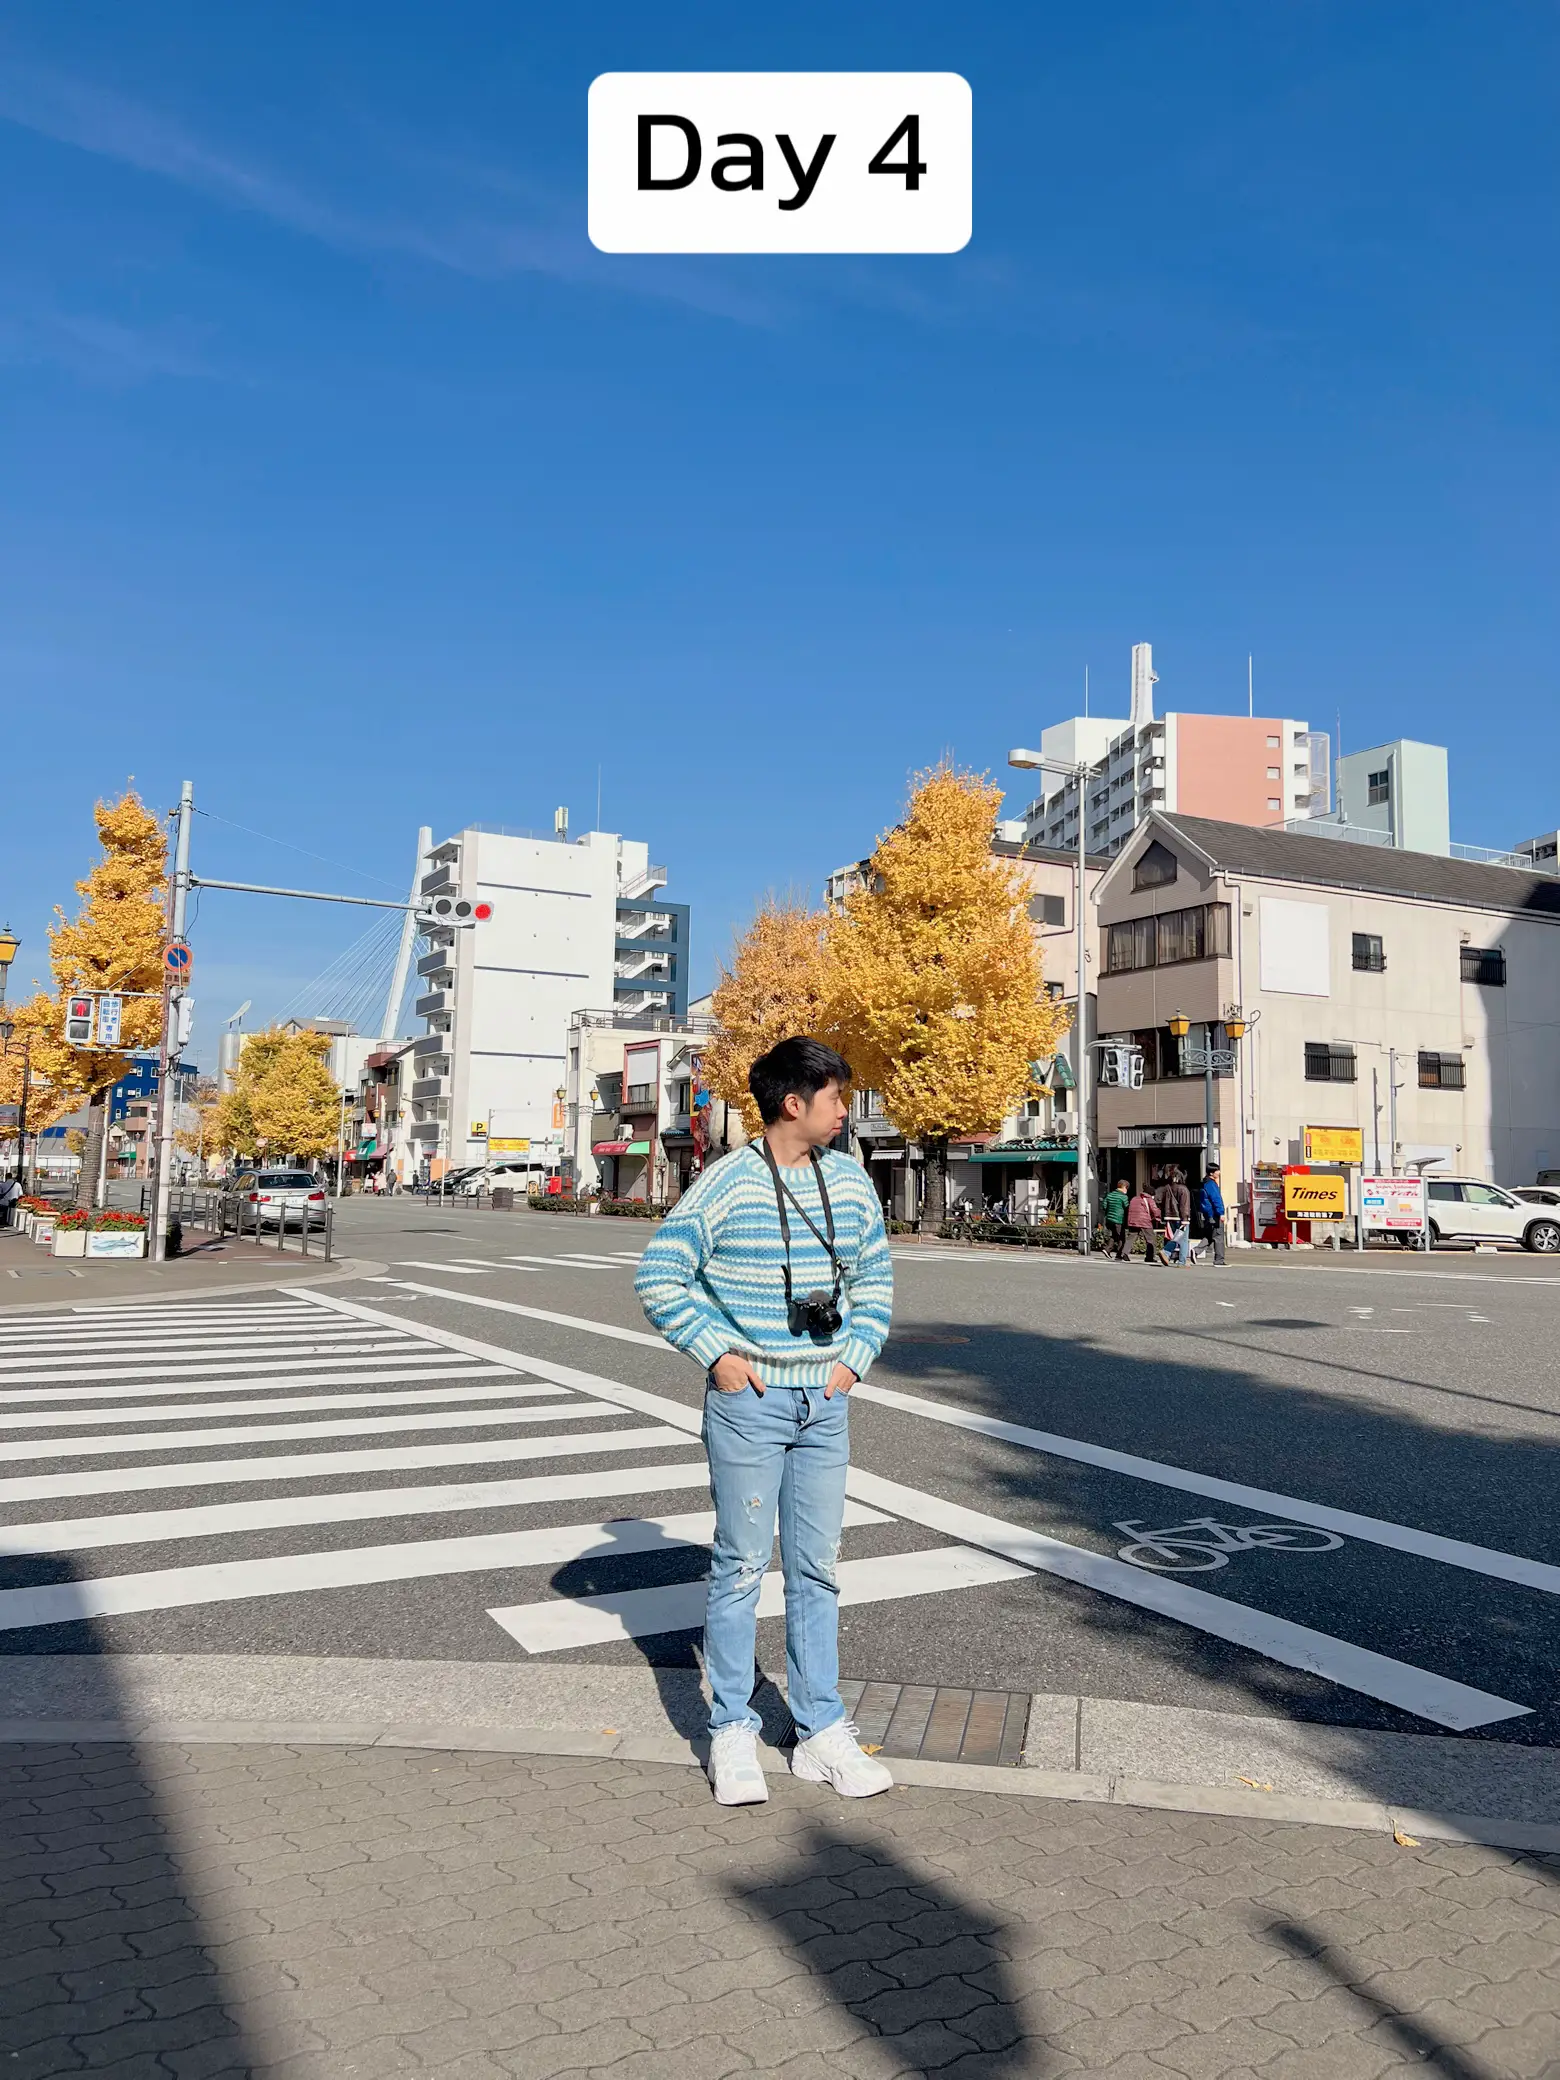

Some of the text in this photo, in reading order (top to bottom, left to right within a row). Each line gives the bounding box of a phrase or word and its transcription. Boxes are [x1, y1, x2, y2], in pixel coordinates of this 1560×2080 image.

[111, 1000, 119, 1024] 歩行者
[476, 1123, 483, 1131] P
[1291, 1187, 1338, 1200] Times
